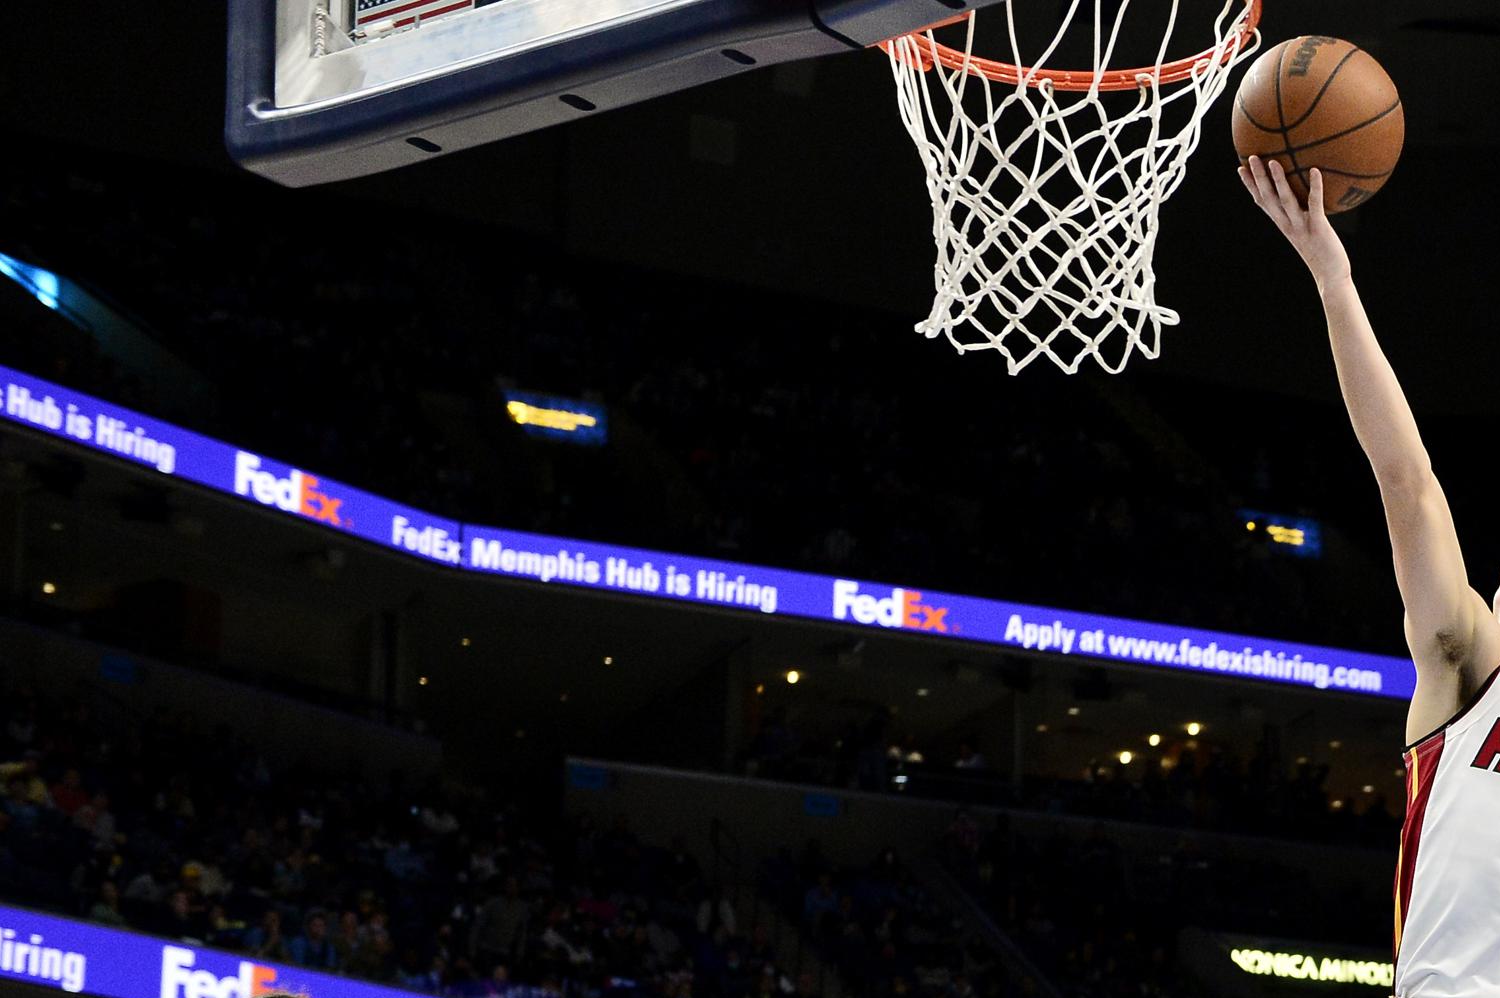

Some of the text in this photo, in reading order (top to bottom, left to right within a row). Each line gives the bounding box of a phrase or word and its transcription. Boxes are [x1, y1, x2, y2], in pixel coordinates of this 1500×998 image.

[7, 383, 62, 430] Hub
[66, 403, 93, 440] is
[96, 413, 176, 475] Hiring
[235, 450, 342, 527] FedEx
[392, 515, 779, 615] FedEx Memphis Hub is Hiring
[833, 579, 946, 634] FedEx
[1005, 614, 1383, 693] Apply at www.fedexishiring.com
[0, 927, 87, 993] iring
[1319, 957, 1393, 987] MINOL
